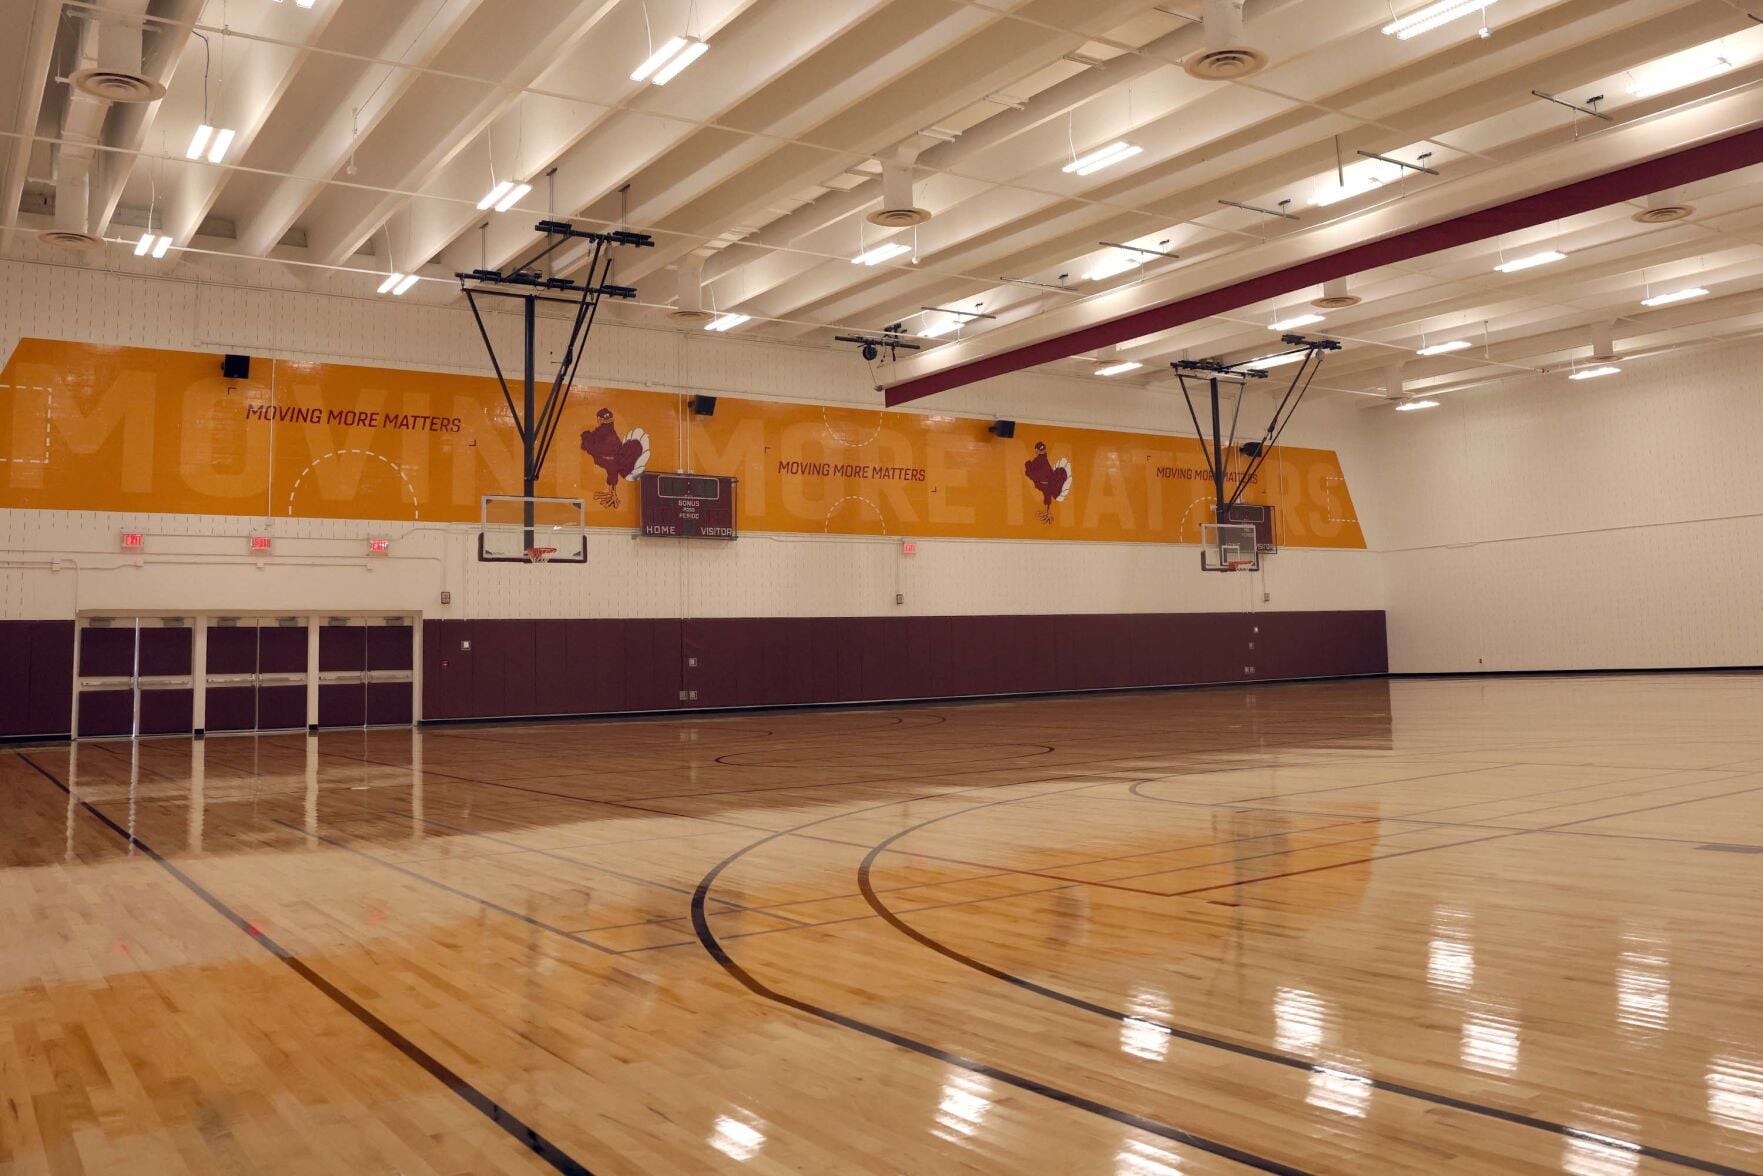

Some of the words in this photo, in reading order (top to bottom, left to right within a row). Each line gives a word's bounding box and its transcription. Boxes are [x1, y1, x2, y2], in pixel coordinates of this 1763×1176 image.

[246, 403, 323, 424] MOVING
[326, 409, 380, 428] MORE
[383, 413, 461, 433] MATTERS
[778, 460, 830, 477] MOVING
[833, 464, 870, 479] MORE
[871, 466, 926, 482] MATTERS
[1156, 467, 1193, 480] MOVING
[1194, 470, 1217, 481] MOR
[646, 525, 676, 535] HOME
[700, 527, 732, 537] VISITOR
